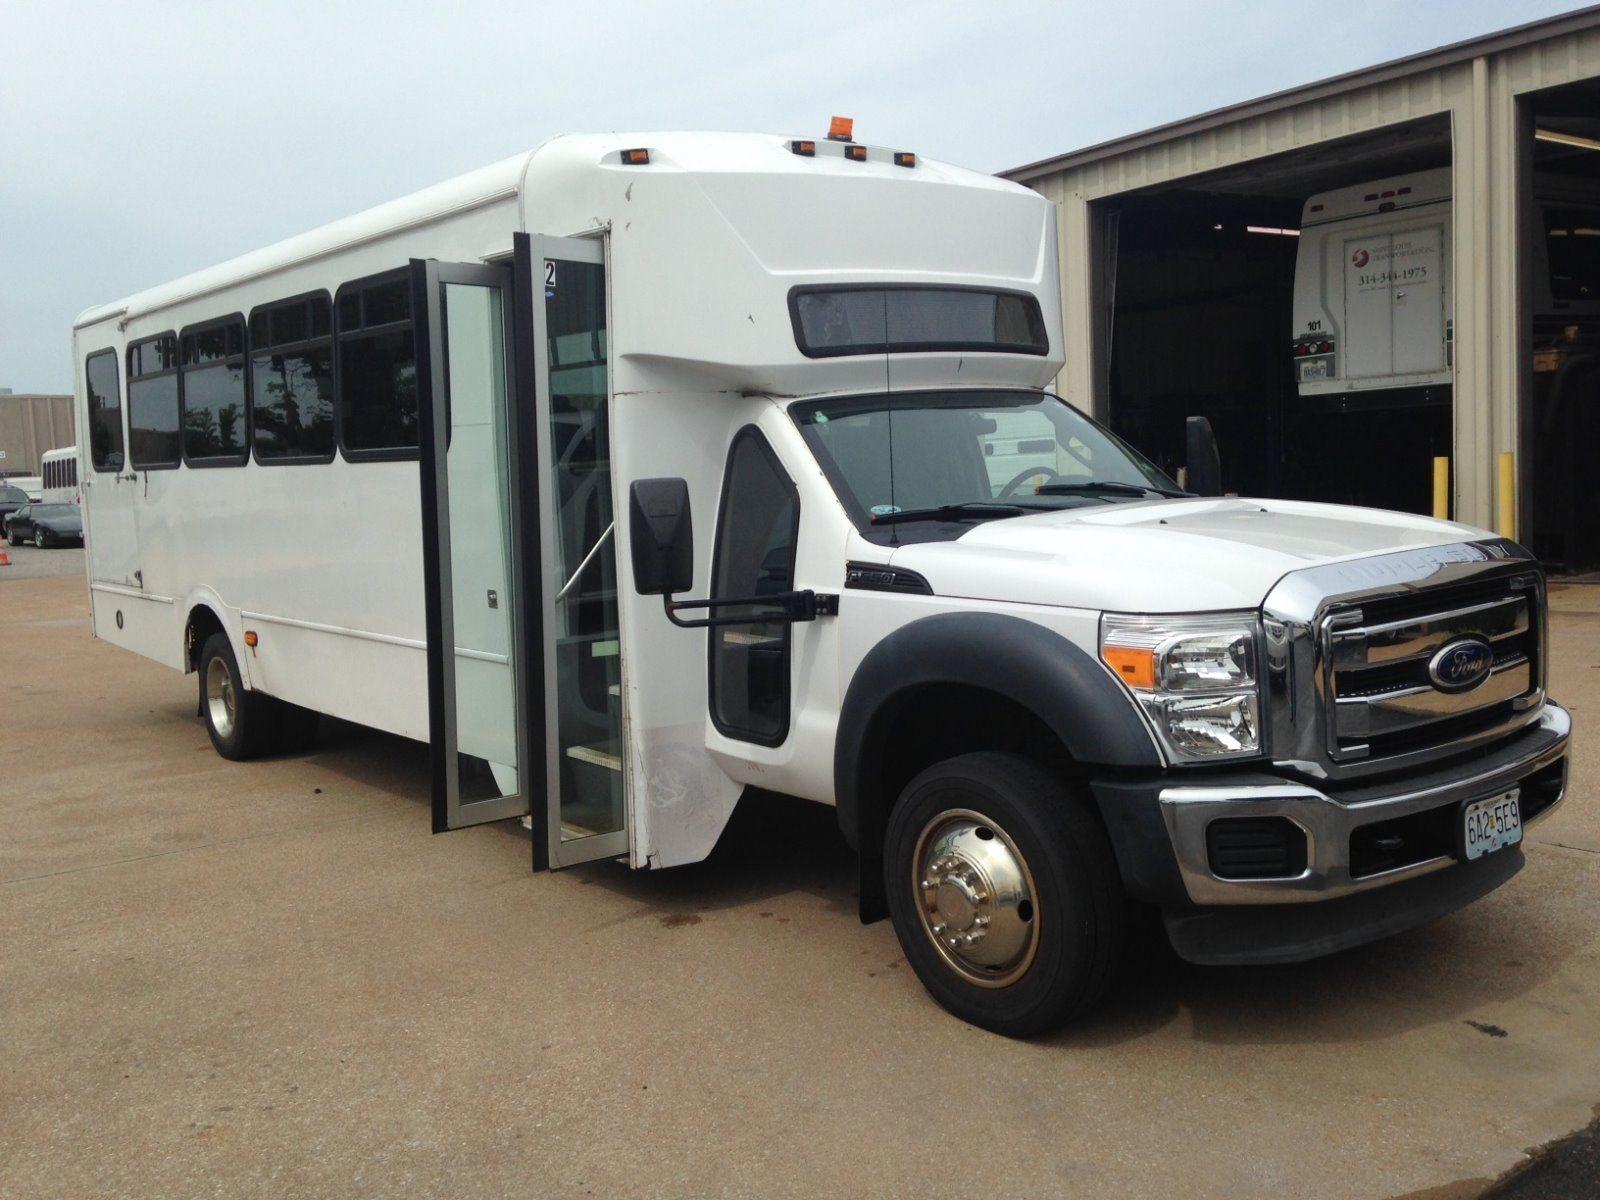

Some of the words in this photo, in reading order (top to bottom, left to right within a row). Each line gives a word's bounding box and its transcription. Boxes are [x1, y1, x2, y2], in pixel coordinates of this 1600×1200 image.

[545, 262, 555, 286] 2
[1307, 320, 1321, 331] 101
[1451, 650, 1484, 678] Ford
[1467, 810, 1491, 845] 6A2
[1494, 800, 1519, 835] 5E9
